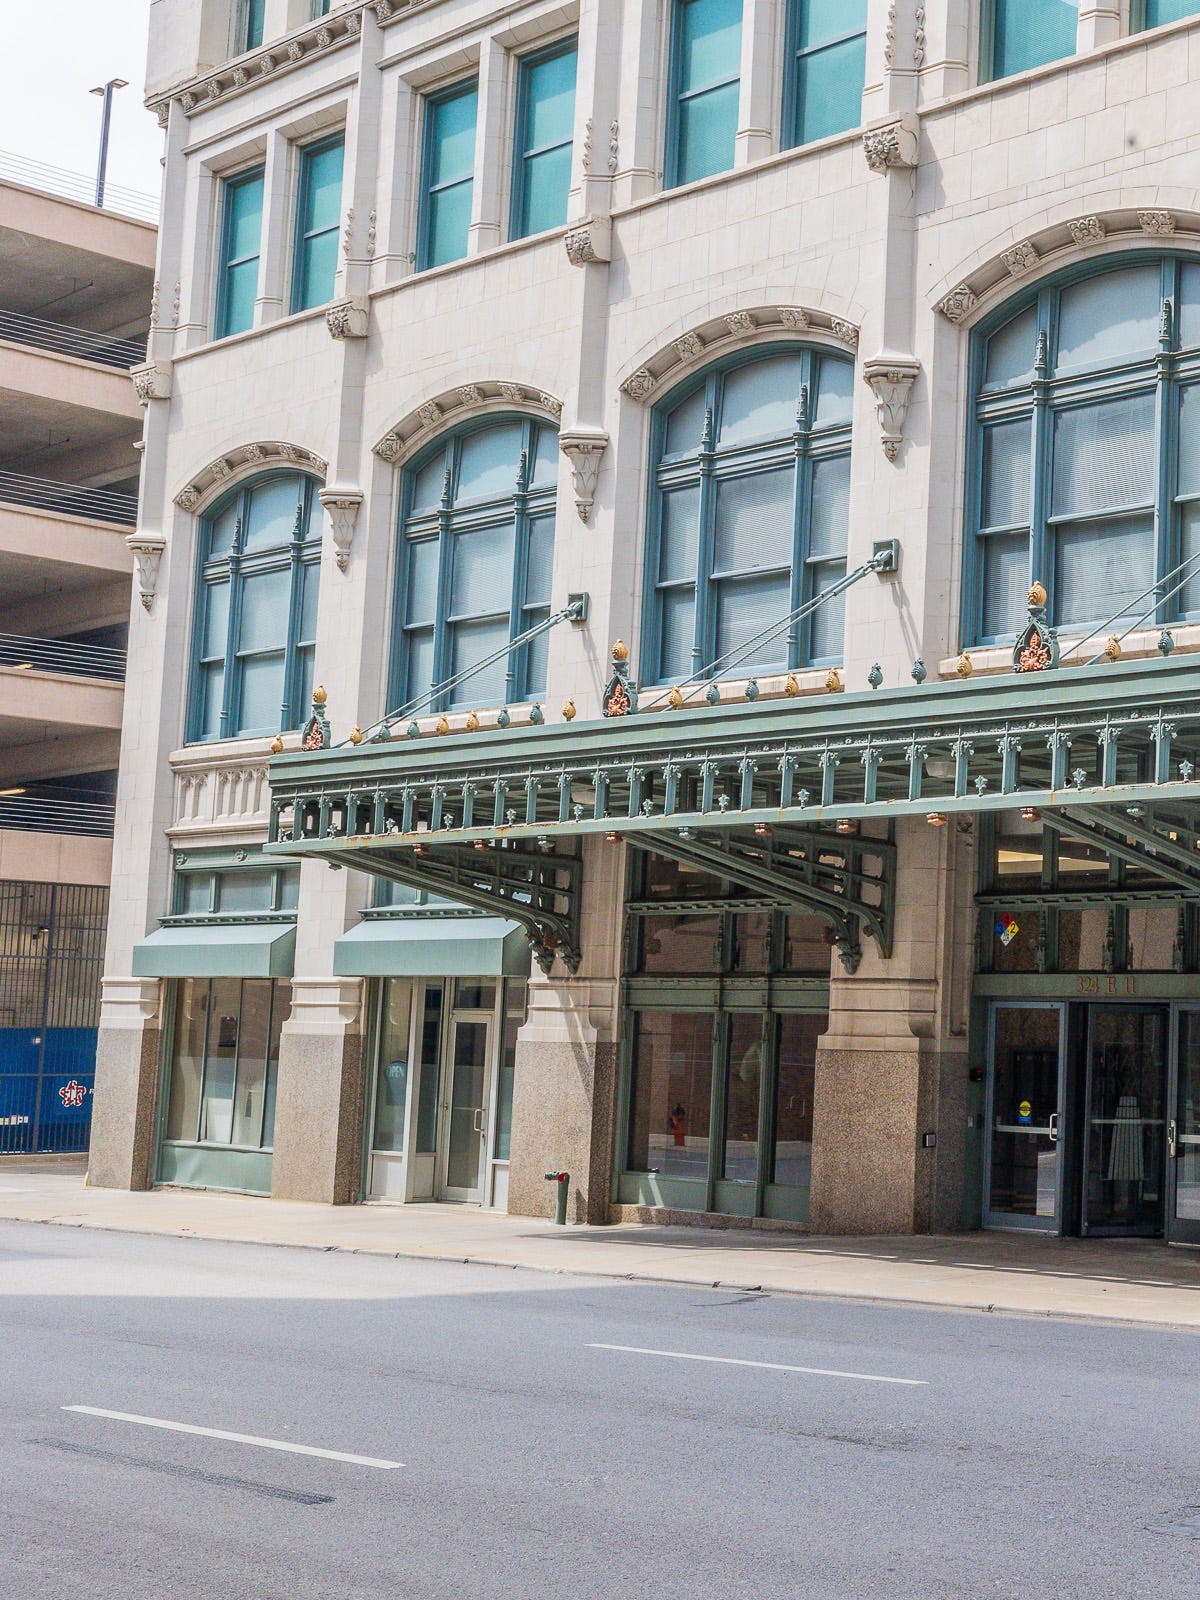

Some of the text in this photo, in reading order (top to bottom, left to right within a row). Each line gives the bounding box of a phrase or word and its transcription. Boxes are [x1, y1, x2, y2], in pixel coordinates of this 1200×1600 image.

[1010, 923, 1016, 933] 2
[1077, 976, 1099, 993] 324
[1105, 976, 1117, 993] E
